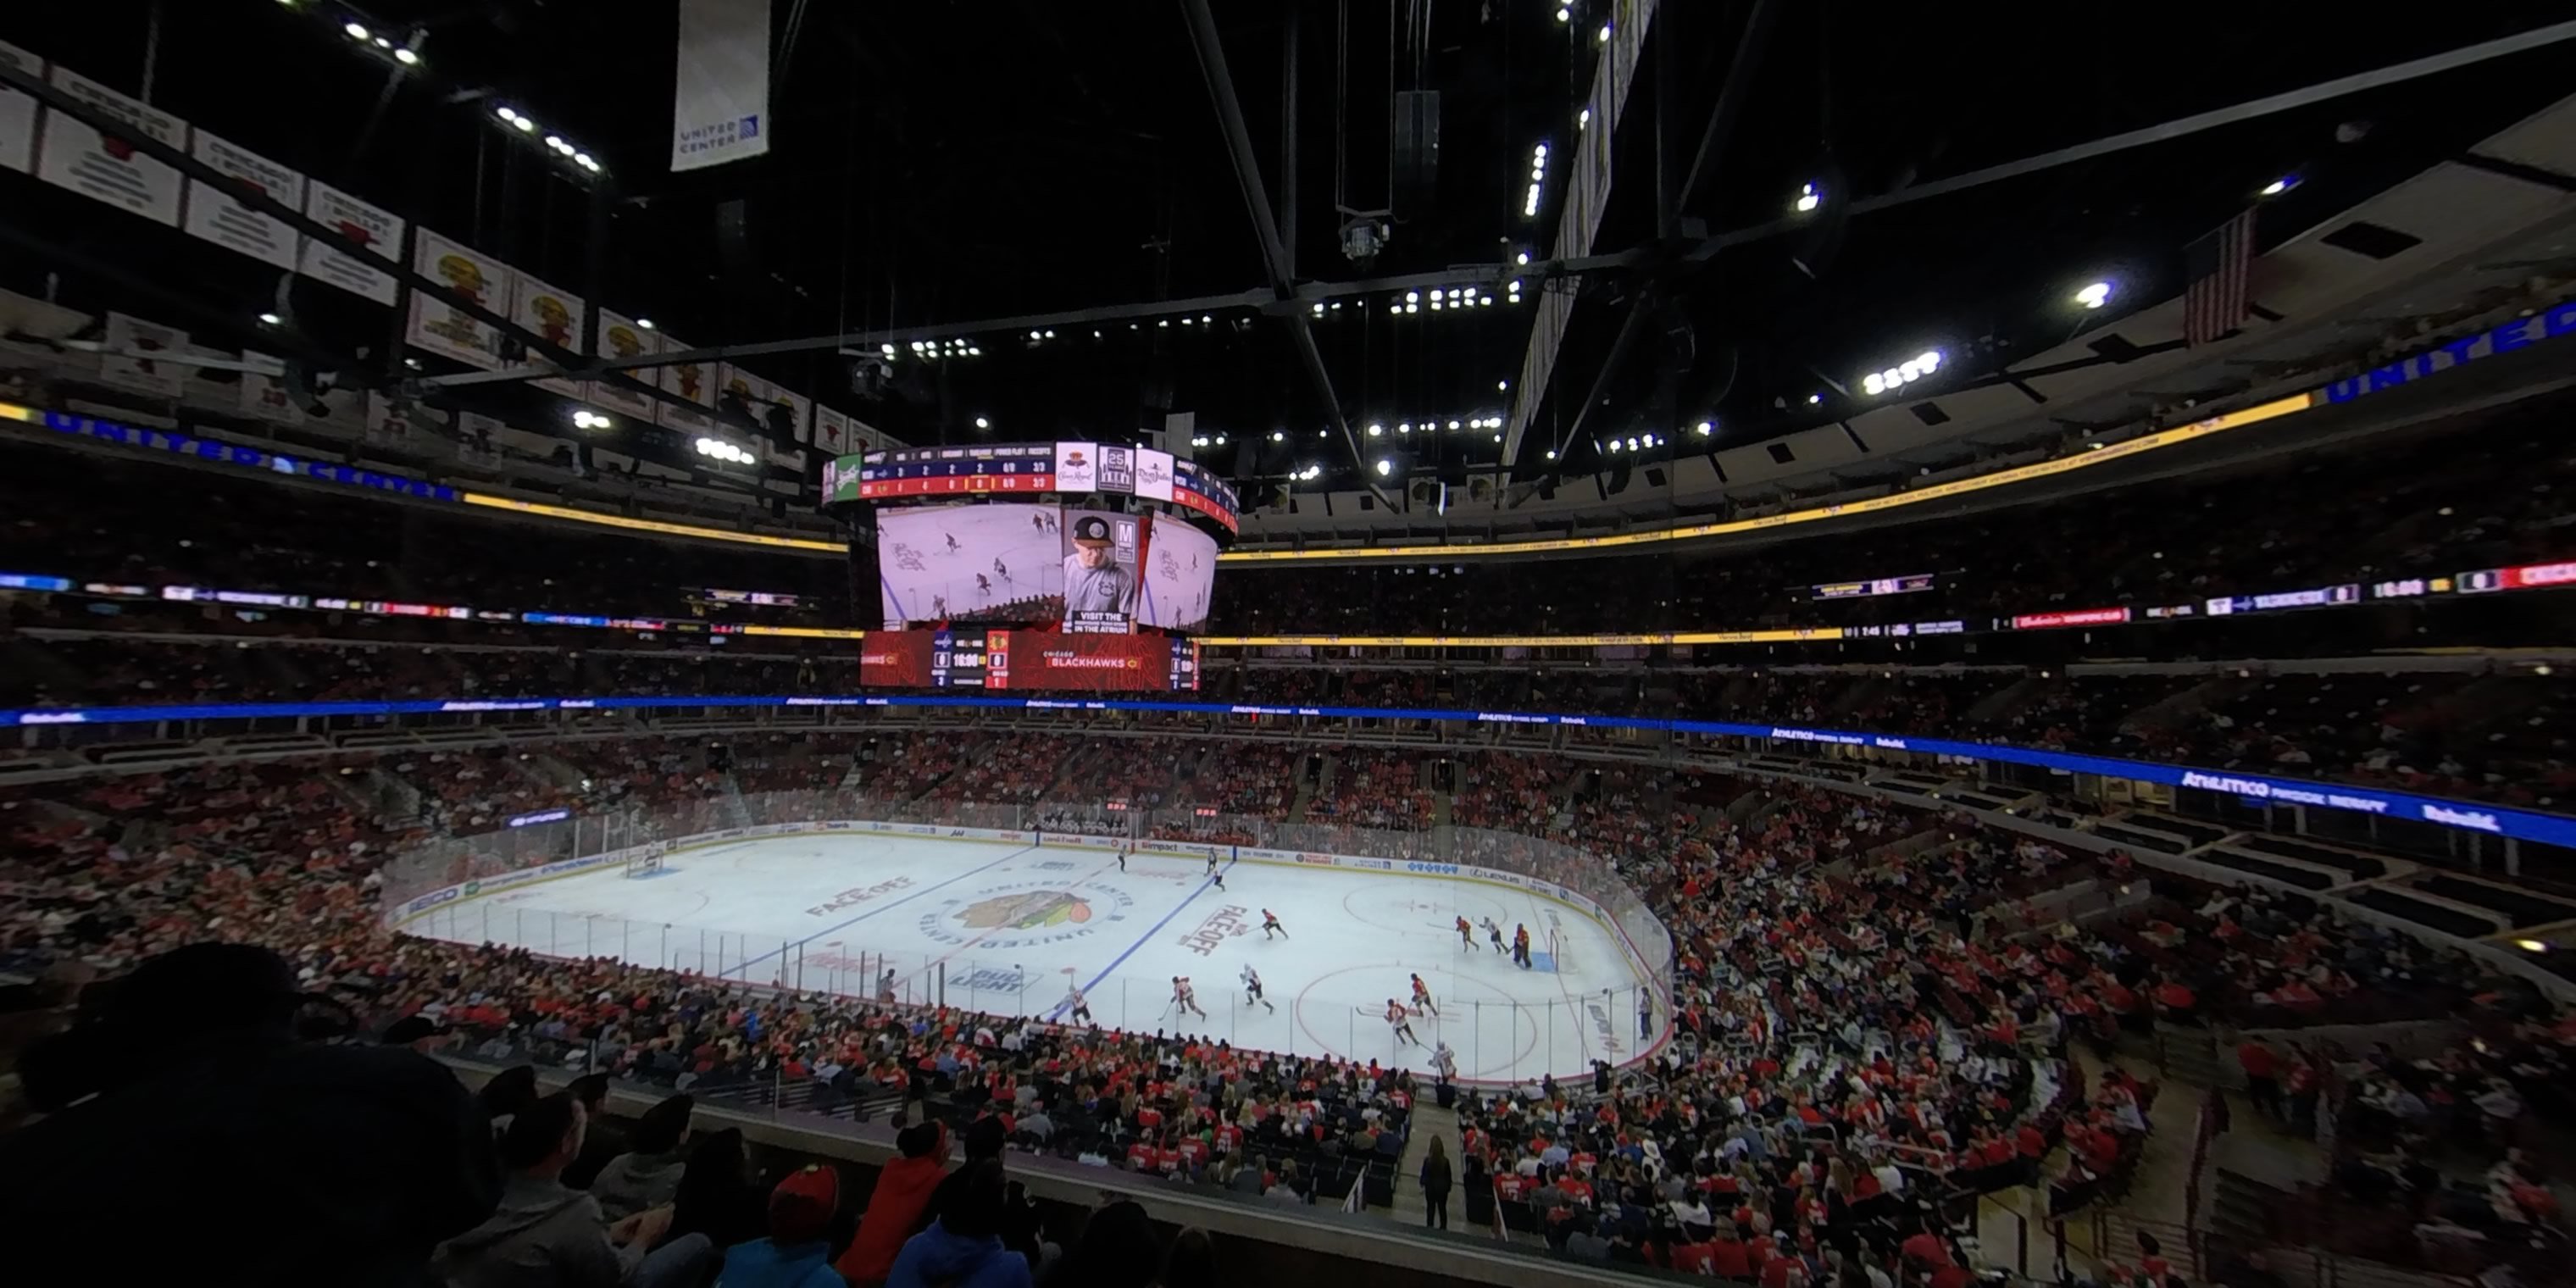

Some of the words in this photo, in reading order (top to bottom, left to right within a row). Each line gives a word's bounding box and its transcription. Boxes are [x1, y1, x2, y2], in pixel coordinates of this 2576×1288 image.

[680, 121, 736, 141] UNITED
[680, 134, 736, 153] CENTER
[2326, 300, 2576, 404] UNITED
[46, 407, 262, 466] UNITED
[1108, 453, 1124, 465] 25
[1119, 524, 1132, 542] M
[1080, 612, 1104, 620] VISIT
[1105, 613, 1122, 621] THE
[1052, 658, 1125, 668] BLACKHAWKS
[1772, 728, 1813, 741] ATHLETICO
[2182, 771, 2269, 798] ATHLETICO
[1483, 872, 1520, 884] LEXUS
[1186, 904, 1247, 957] FACE-OFF
[974, 969, 1024, 982] BUD
